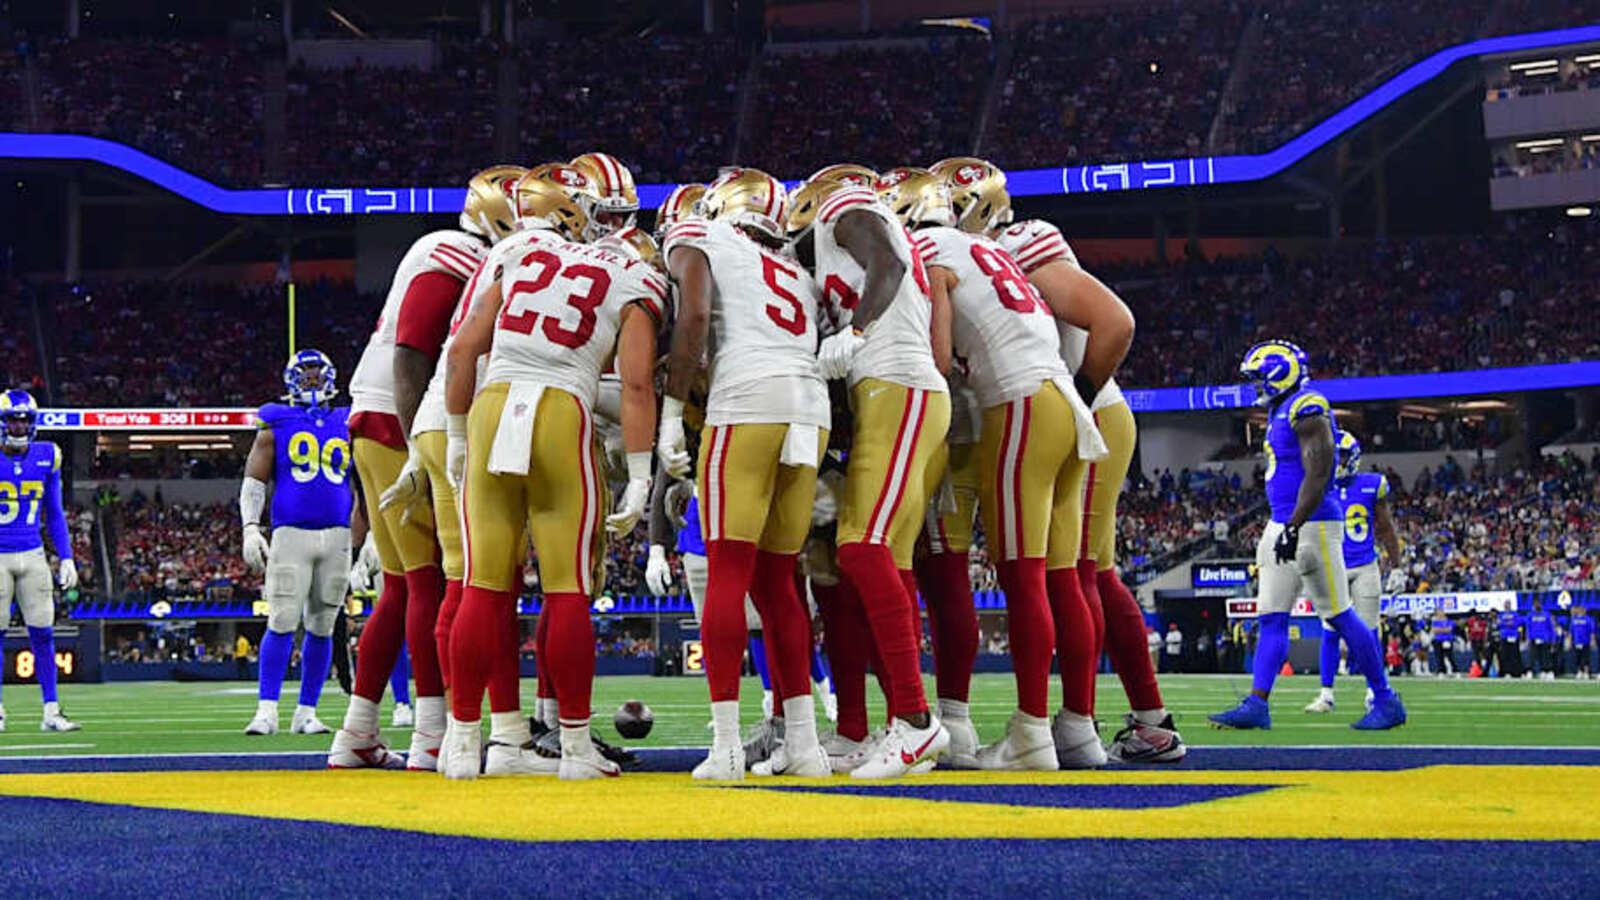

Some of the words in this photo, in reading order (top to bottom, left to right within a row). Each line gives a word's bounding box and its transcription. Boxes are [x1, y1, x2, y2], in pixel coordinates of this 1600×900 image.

[499, 248, 612, 350] 23
[760, 254, 807, 337] 5
[97, 413, 127, 424] Total
[288, 431, 351, 485] 90
[1199, 567, 1220, 582] Live
